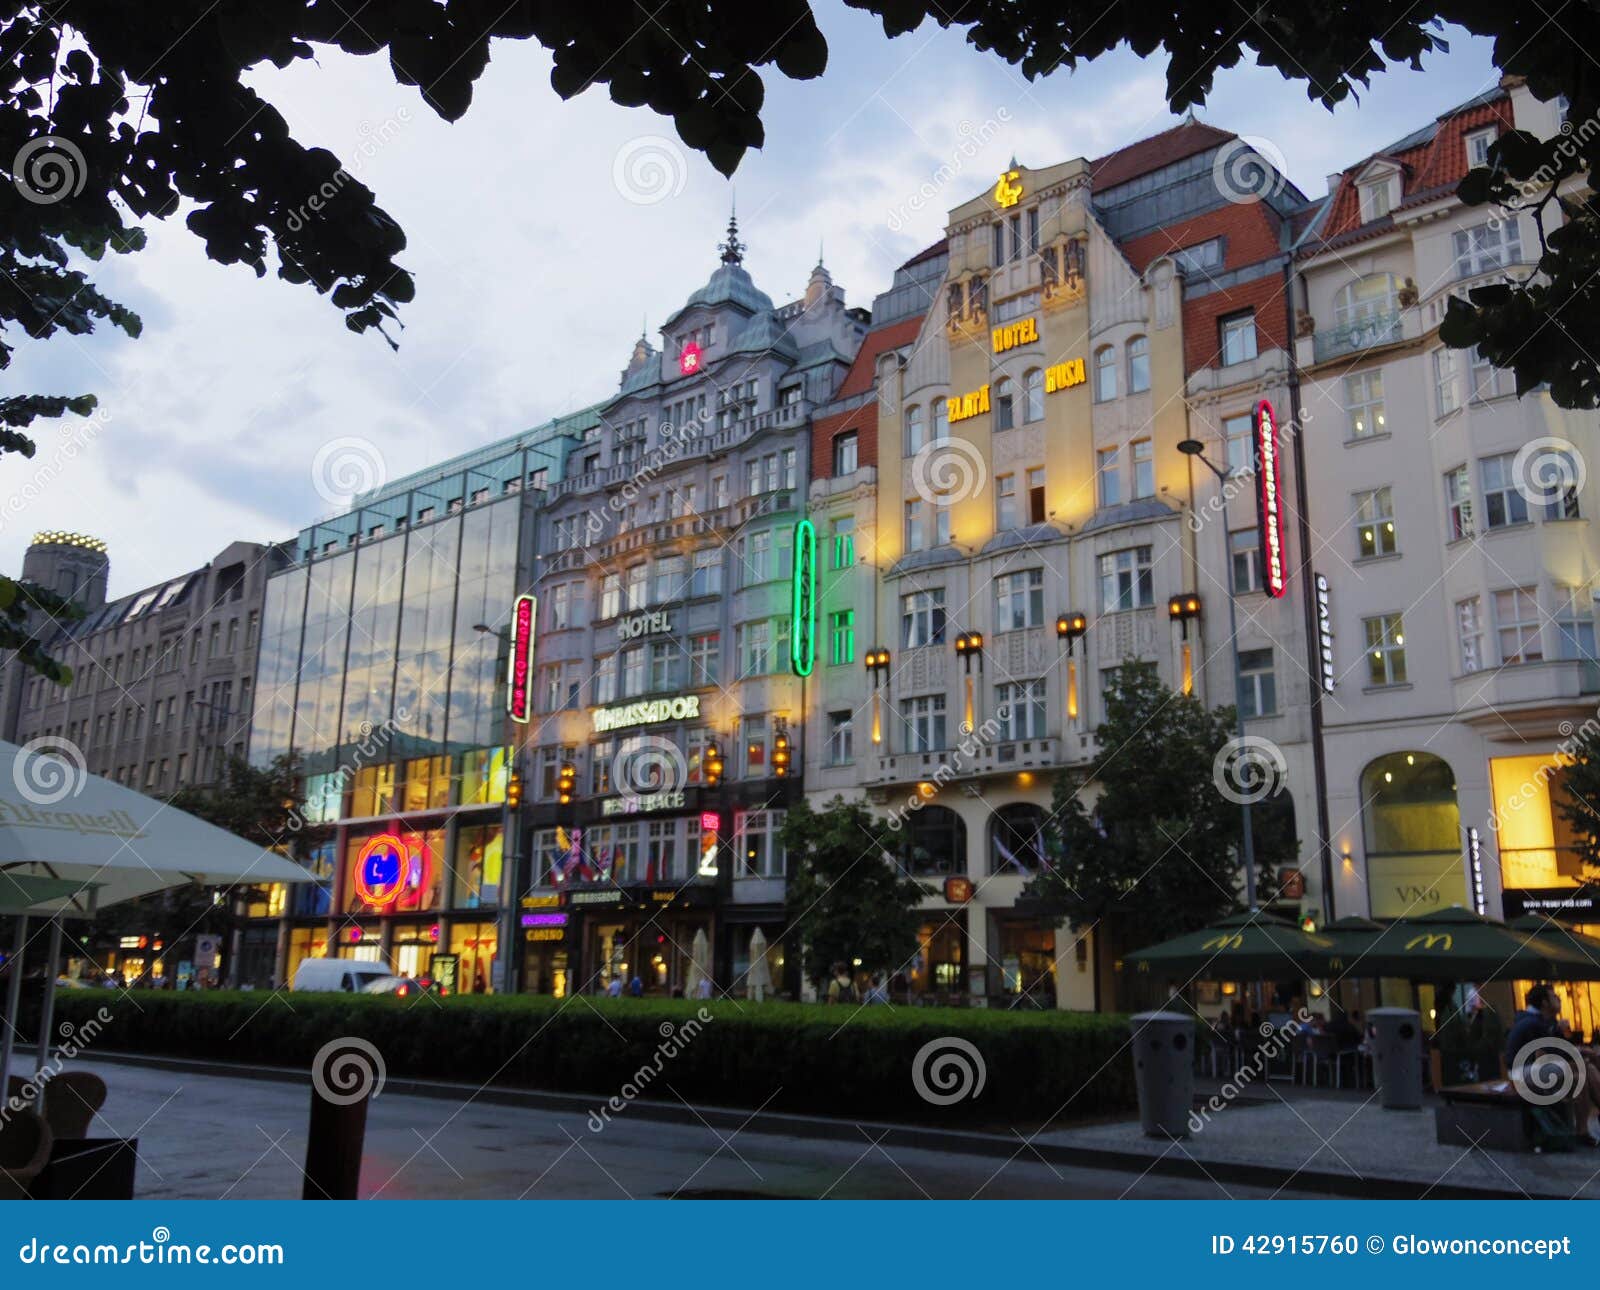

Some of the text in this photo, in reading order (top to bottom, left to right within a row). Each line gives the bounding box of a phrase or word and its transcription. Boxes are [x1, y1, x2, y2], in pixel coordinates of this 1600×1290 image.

[992, 317, 1039, 353] HOTEL
[1045, 358, 1086, 393] HUSA
[617, 611, 672, 639] HOTEL
[1318, 576, 1334, 691] RESERVED
[1395, 885, 1440, 904] VN9
